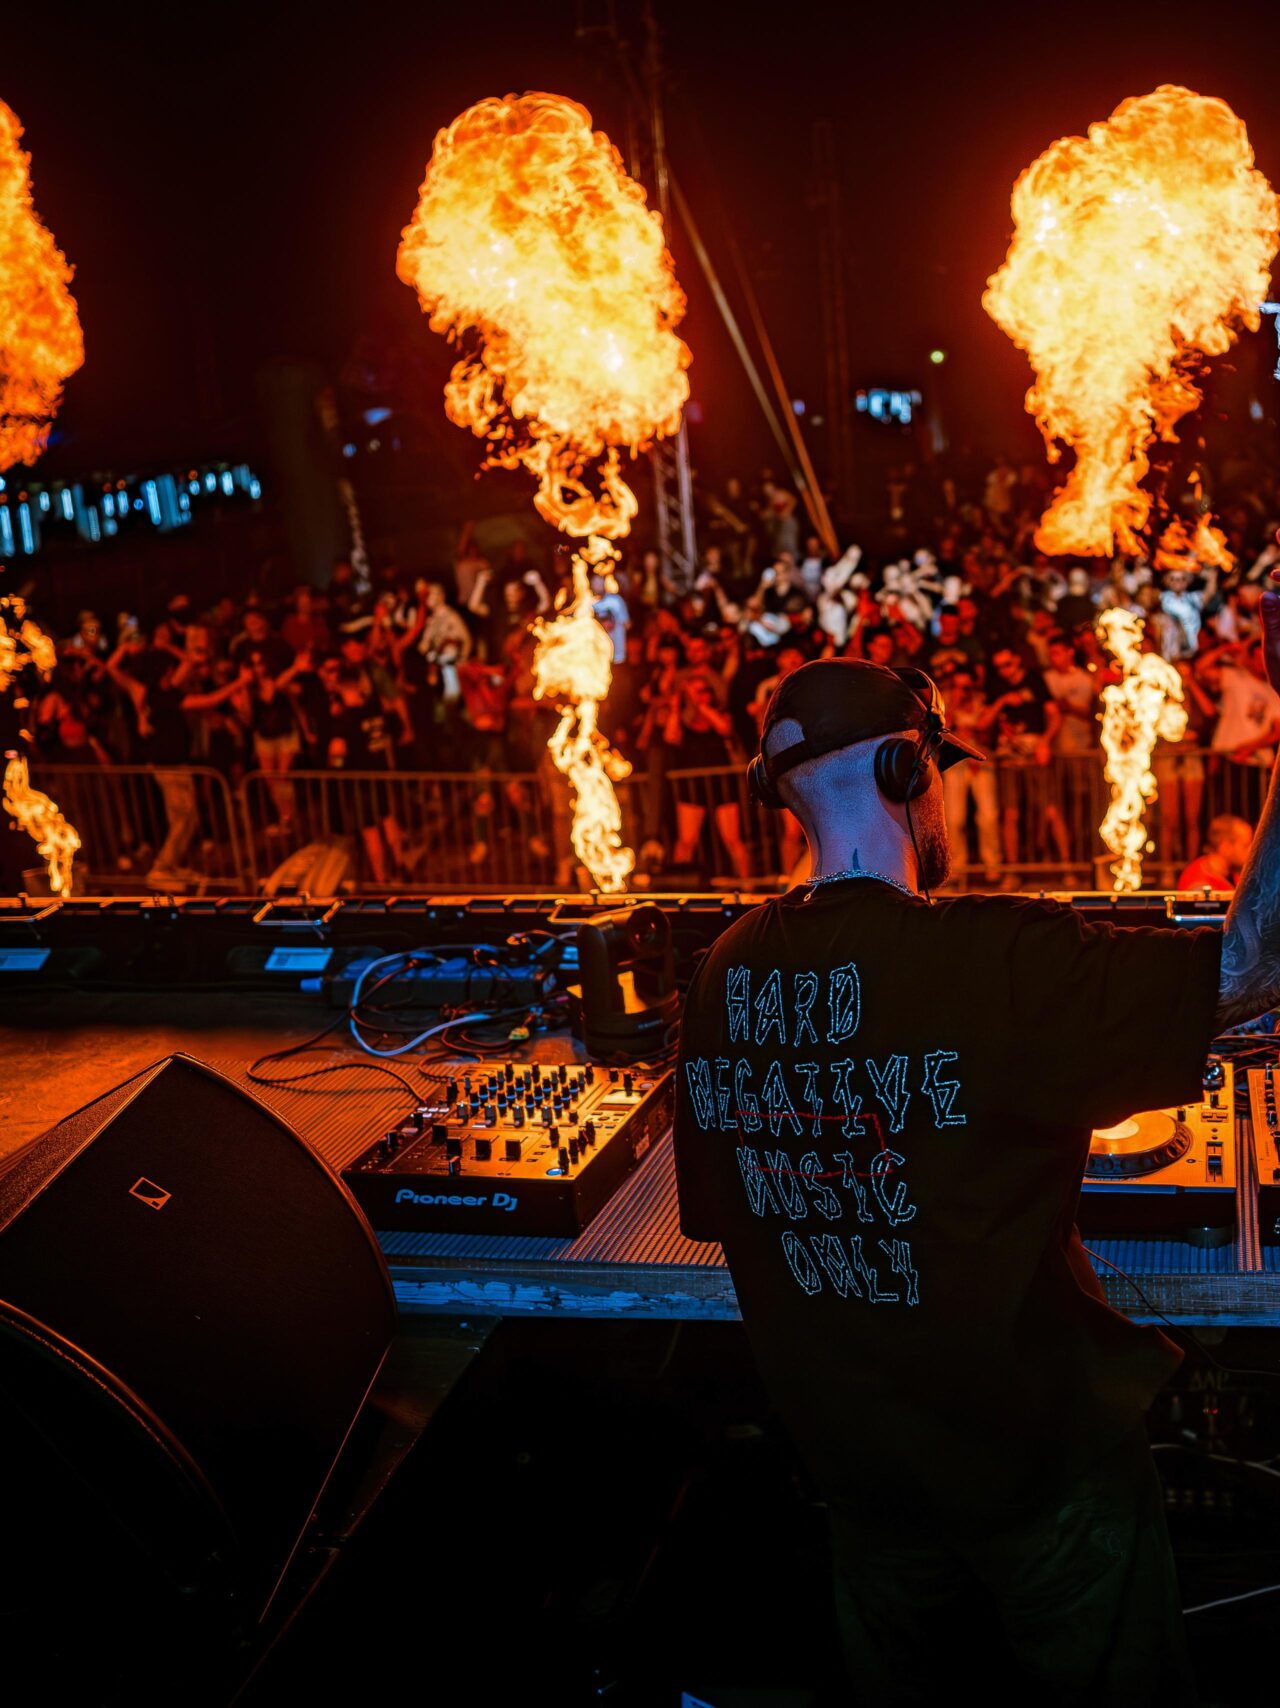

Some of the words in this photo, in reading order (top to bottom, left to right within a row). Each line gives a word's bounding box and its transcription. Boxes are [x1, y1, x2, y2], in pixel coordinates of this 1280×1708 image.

[726, 962, 860, 1046] HARD
[685, 1050, 966, 1138] NEGATIVE
[395, 1188, 488, 1206] Pioneer
[736, 1146, 917, 1226] MUSIC
[781, 1231, 920, 1305] ONLY
